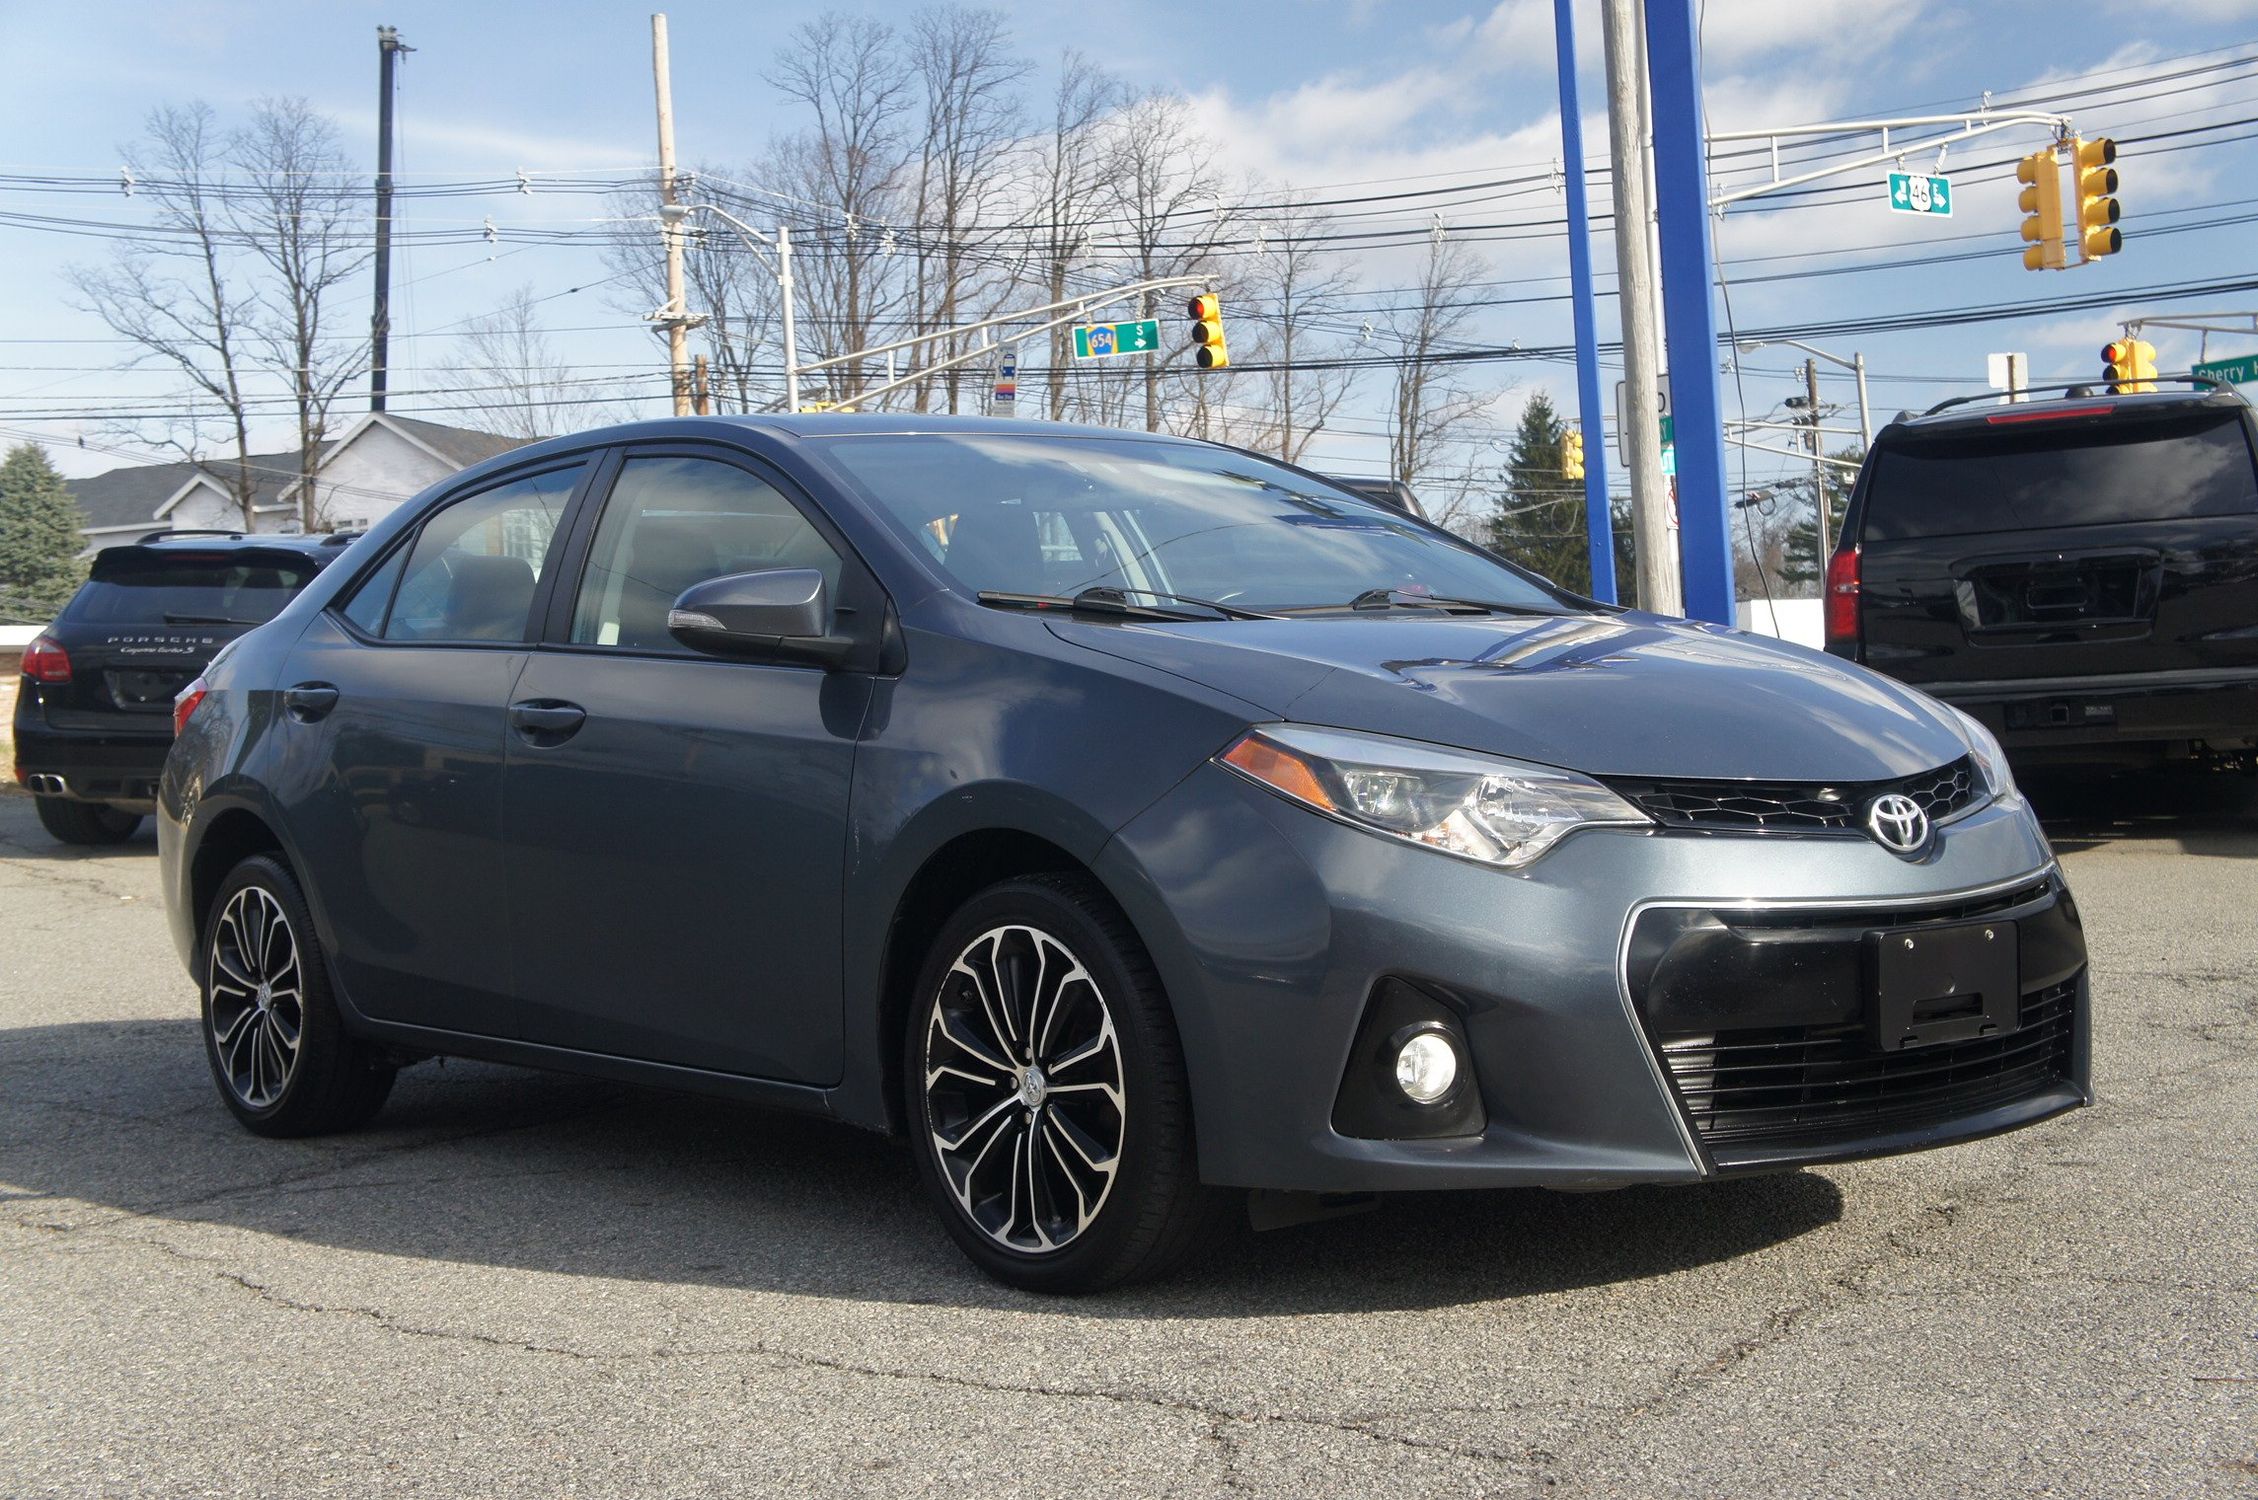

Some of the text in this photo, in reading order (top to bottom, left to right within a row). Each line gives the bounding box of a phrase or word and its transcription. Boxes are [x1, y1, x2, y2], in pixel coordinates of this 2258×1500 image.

[1912, 184, 1928, 203] 46
[1135, 324, 1144, 336] S
[1091, 332, 1113, 348] 654
[107, 636, 213, 644] PORSCHE
